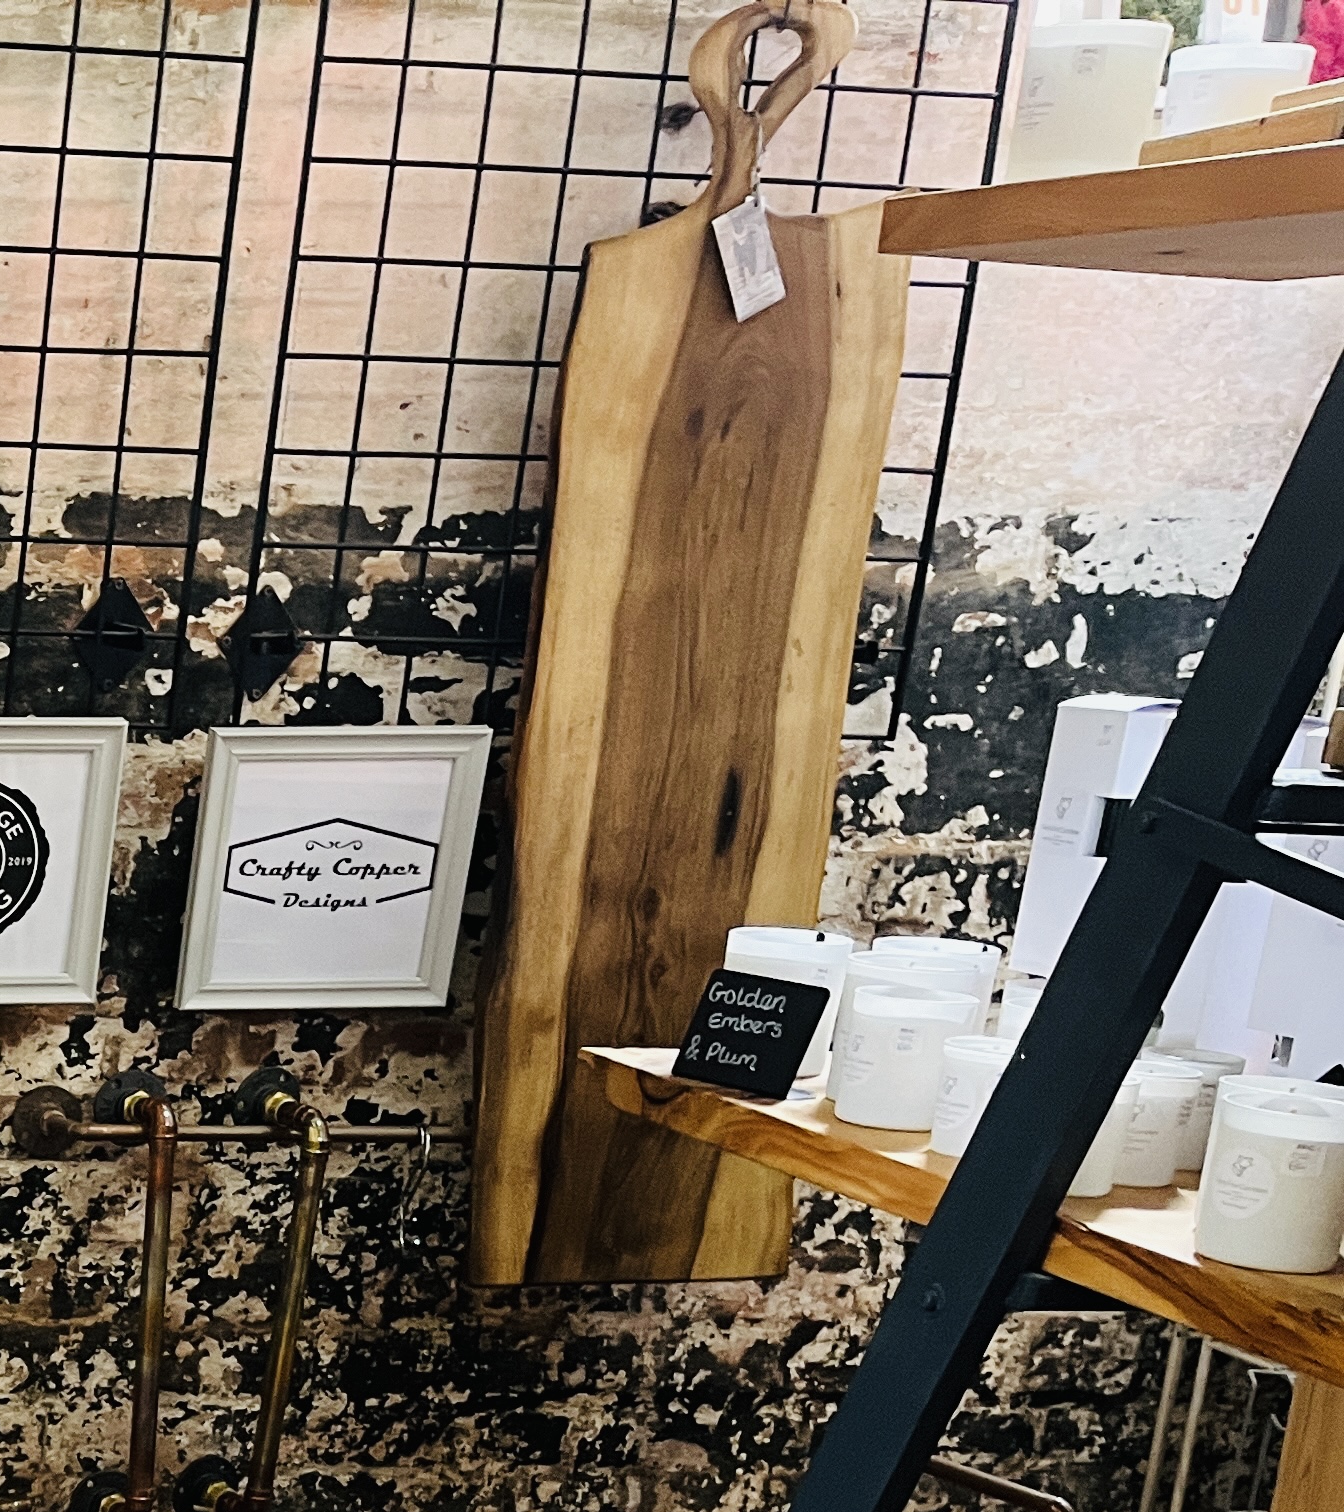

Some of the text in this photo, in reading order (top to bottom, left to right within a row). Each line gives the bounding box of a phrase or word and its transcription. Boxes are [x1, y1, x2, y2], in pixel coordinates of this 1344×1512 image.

[7, 856, 33, 867] 2019
[239, 857, 421, 882] Crafty Copper
[283, 892, 368, 911] Designs
[708, 981, 787, 1014] Golden
[708, 1012, 783, 1038] Embers
[684, 1034, 758, 1071] & Plum
